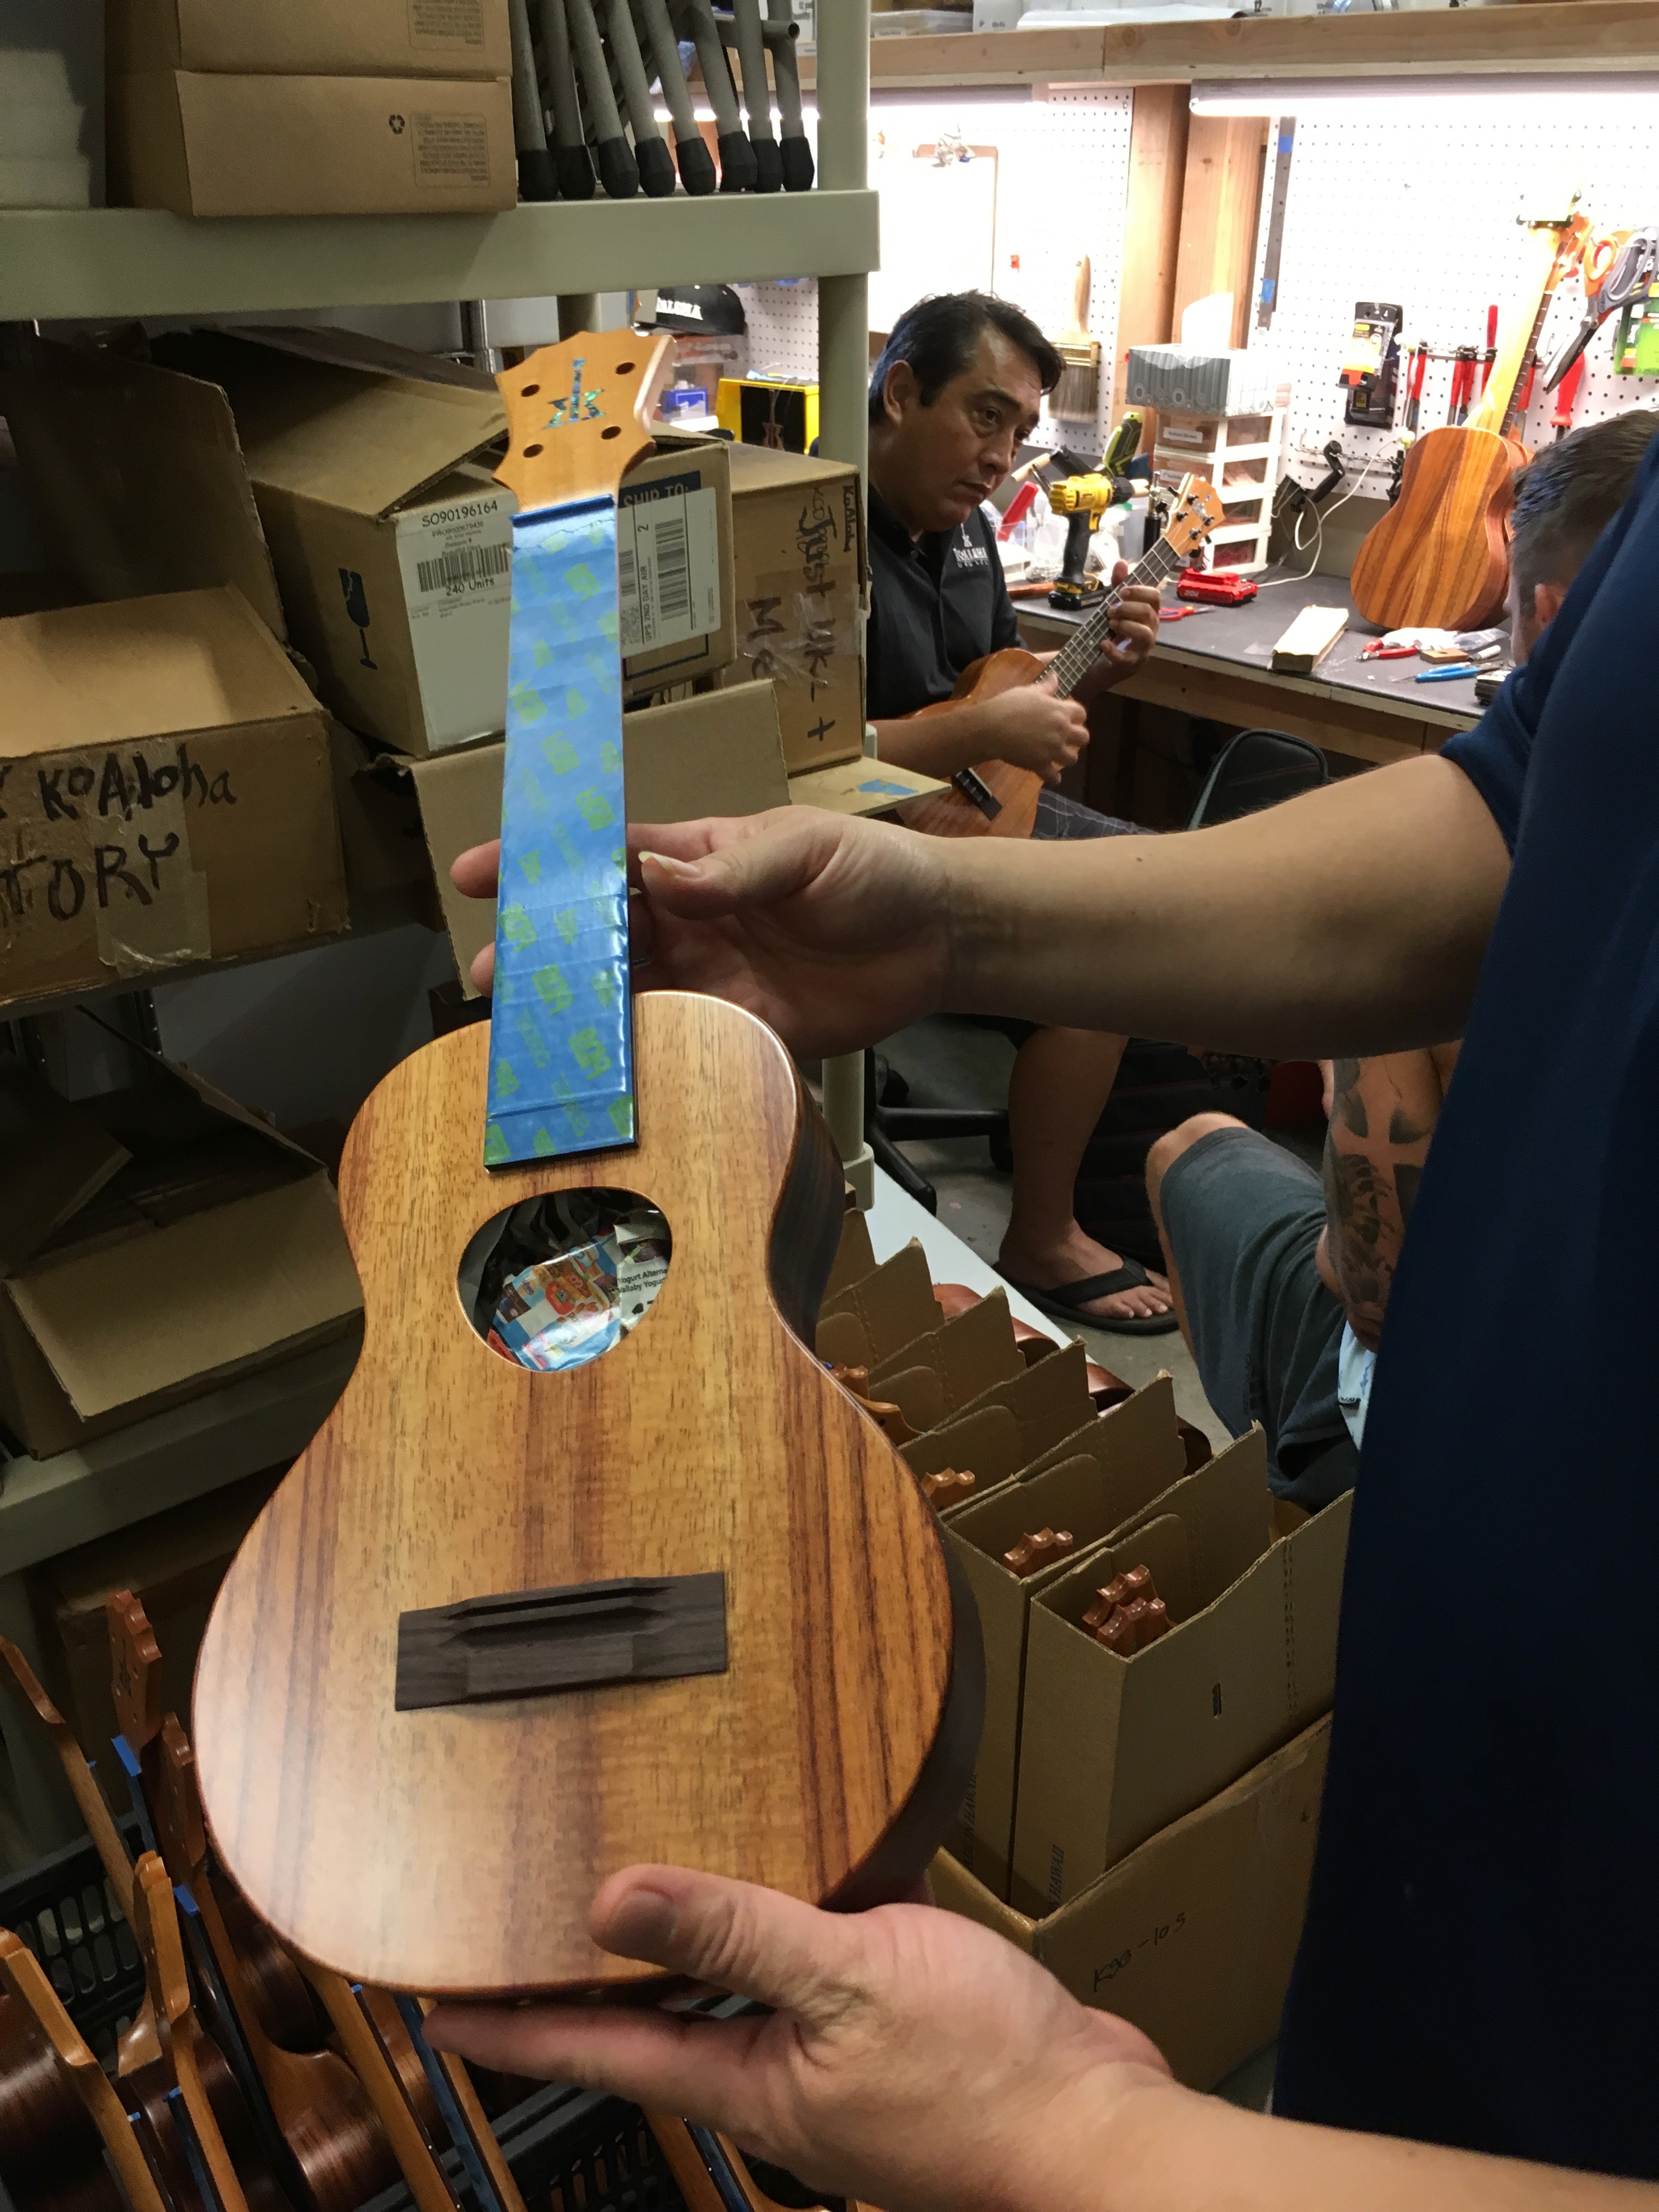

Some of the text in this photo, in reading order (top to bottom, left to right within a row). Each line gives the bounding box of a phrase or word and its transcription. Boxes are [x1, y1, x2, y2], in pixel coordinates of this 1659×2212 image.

[422, 500, 498, 528] SO90196164
[446, 577, 495, 596] 240 Units
[643, 603, 651, 622] 2ND
[1048, 1843, 1064, 1900] HAWAII
